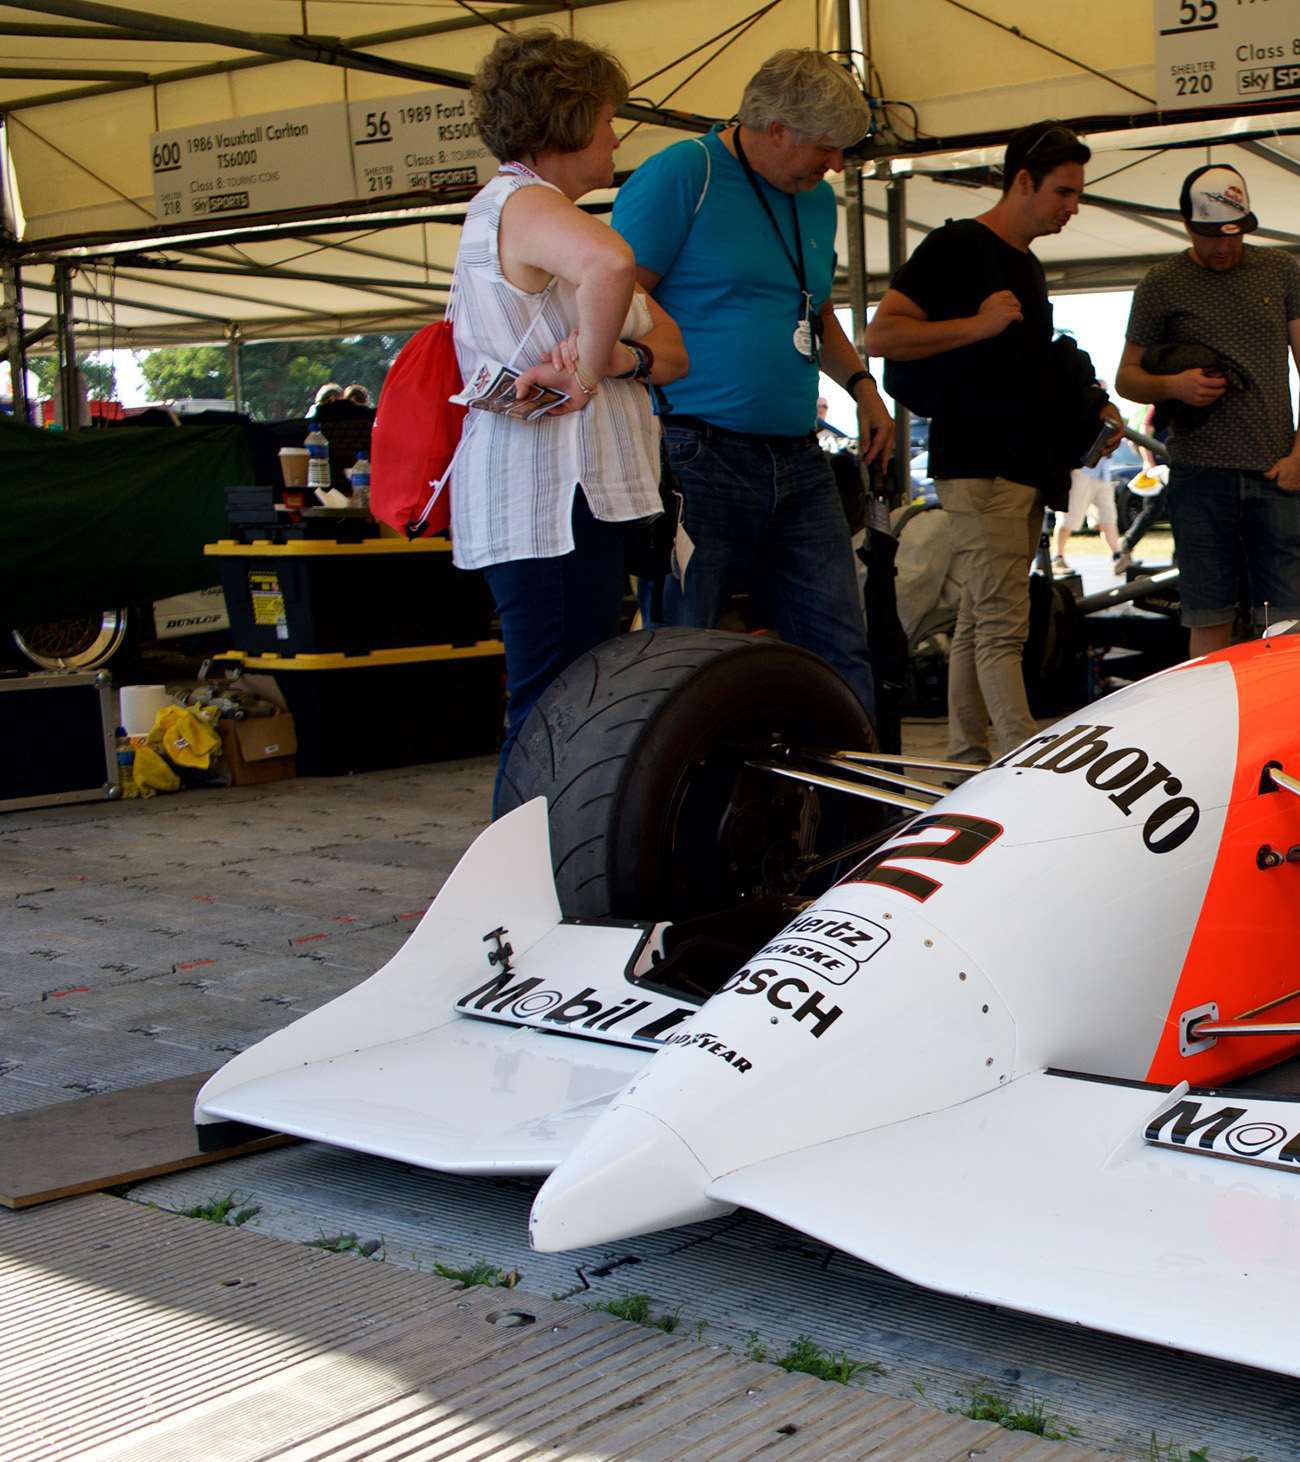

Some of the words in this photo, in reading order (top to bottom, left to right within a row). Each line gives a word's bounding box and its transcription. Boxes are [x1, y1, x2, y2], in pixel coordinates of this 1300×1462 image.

[1235, 42, 1285, 62] Class
[1170, 61, 1216, 76] SHELTER
[1175, 74, 1213, 96] 220
[1241, 70, 1270, 93] sky
[398, 103, 431, 124] 1989
[436, 102, 465, 119] Ford
[366, 111, 392, 138] 56
[187, 136, 213, 154] 1986
[215, 127, 263, 150] Vauxhall
[265, 122, 308, 141] Carlton
[152, 141, 181, 168] 600
[216, 149, 258, 169] TS6000
[405, 154, 434, 168] Class
[189, 178, 215, 194] Class
[367, 176, 393, 192] 219
[409, 173, 429, 188] sky
[431, 167, 477, 185] SPORTS
[162, 202, 183, 217] 218
[192, 199, 209, 213] sky
[209, 193, 248, 211] SPORTS
[165, 614, 223, 629] DUNLOP
[996, 724, 1200, 854] rlboro
[832, 813, 1004, 904] 2
[456, 970, 652, 1033] Mobil
[719, 968, 844, 1039] OSCH
